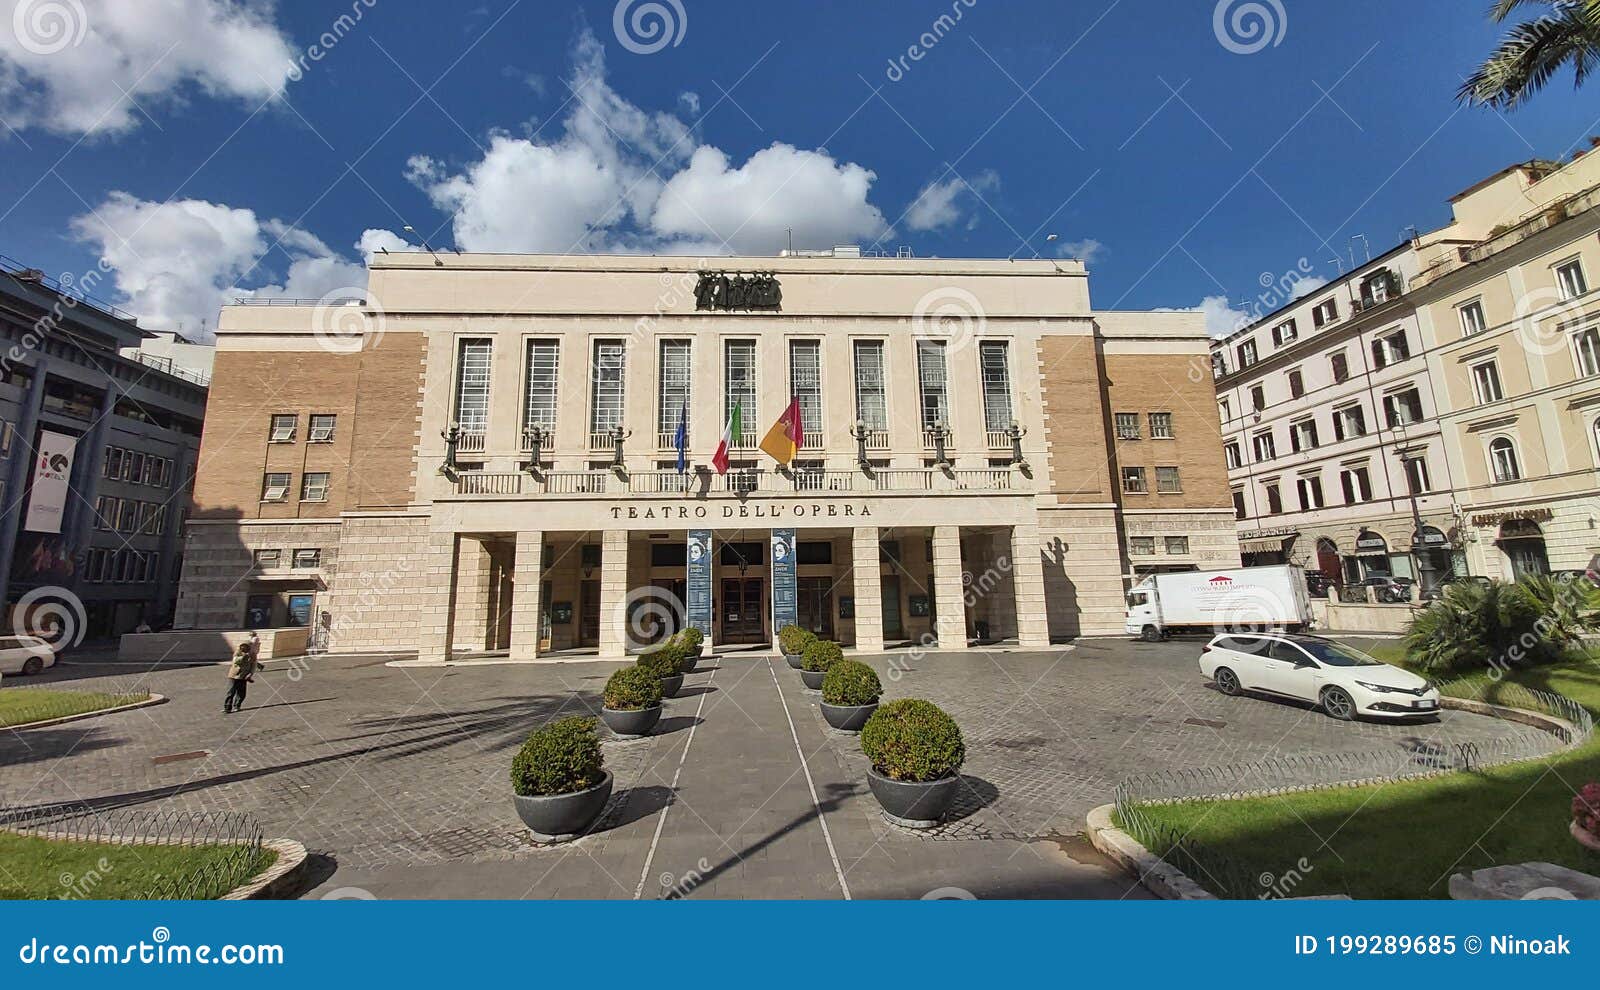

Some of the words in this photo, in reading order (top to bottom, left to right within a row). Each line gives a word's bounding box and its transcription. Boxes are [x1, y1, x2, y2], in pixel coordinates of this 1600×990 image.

[611, 506, 707, 519] TEATRO
[722, 505, 786, 518] DELL'
[794, 504, 872, 517] OPERA
